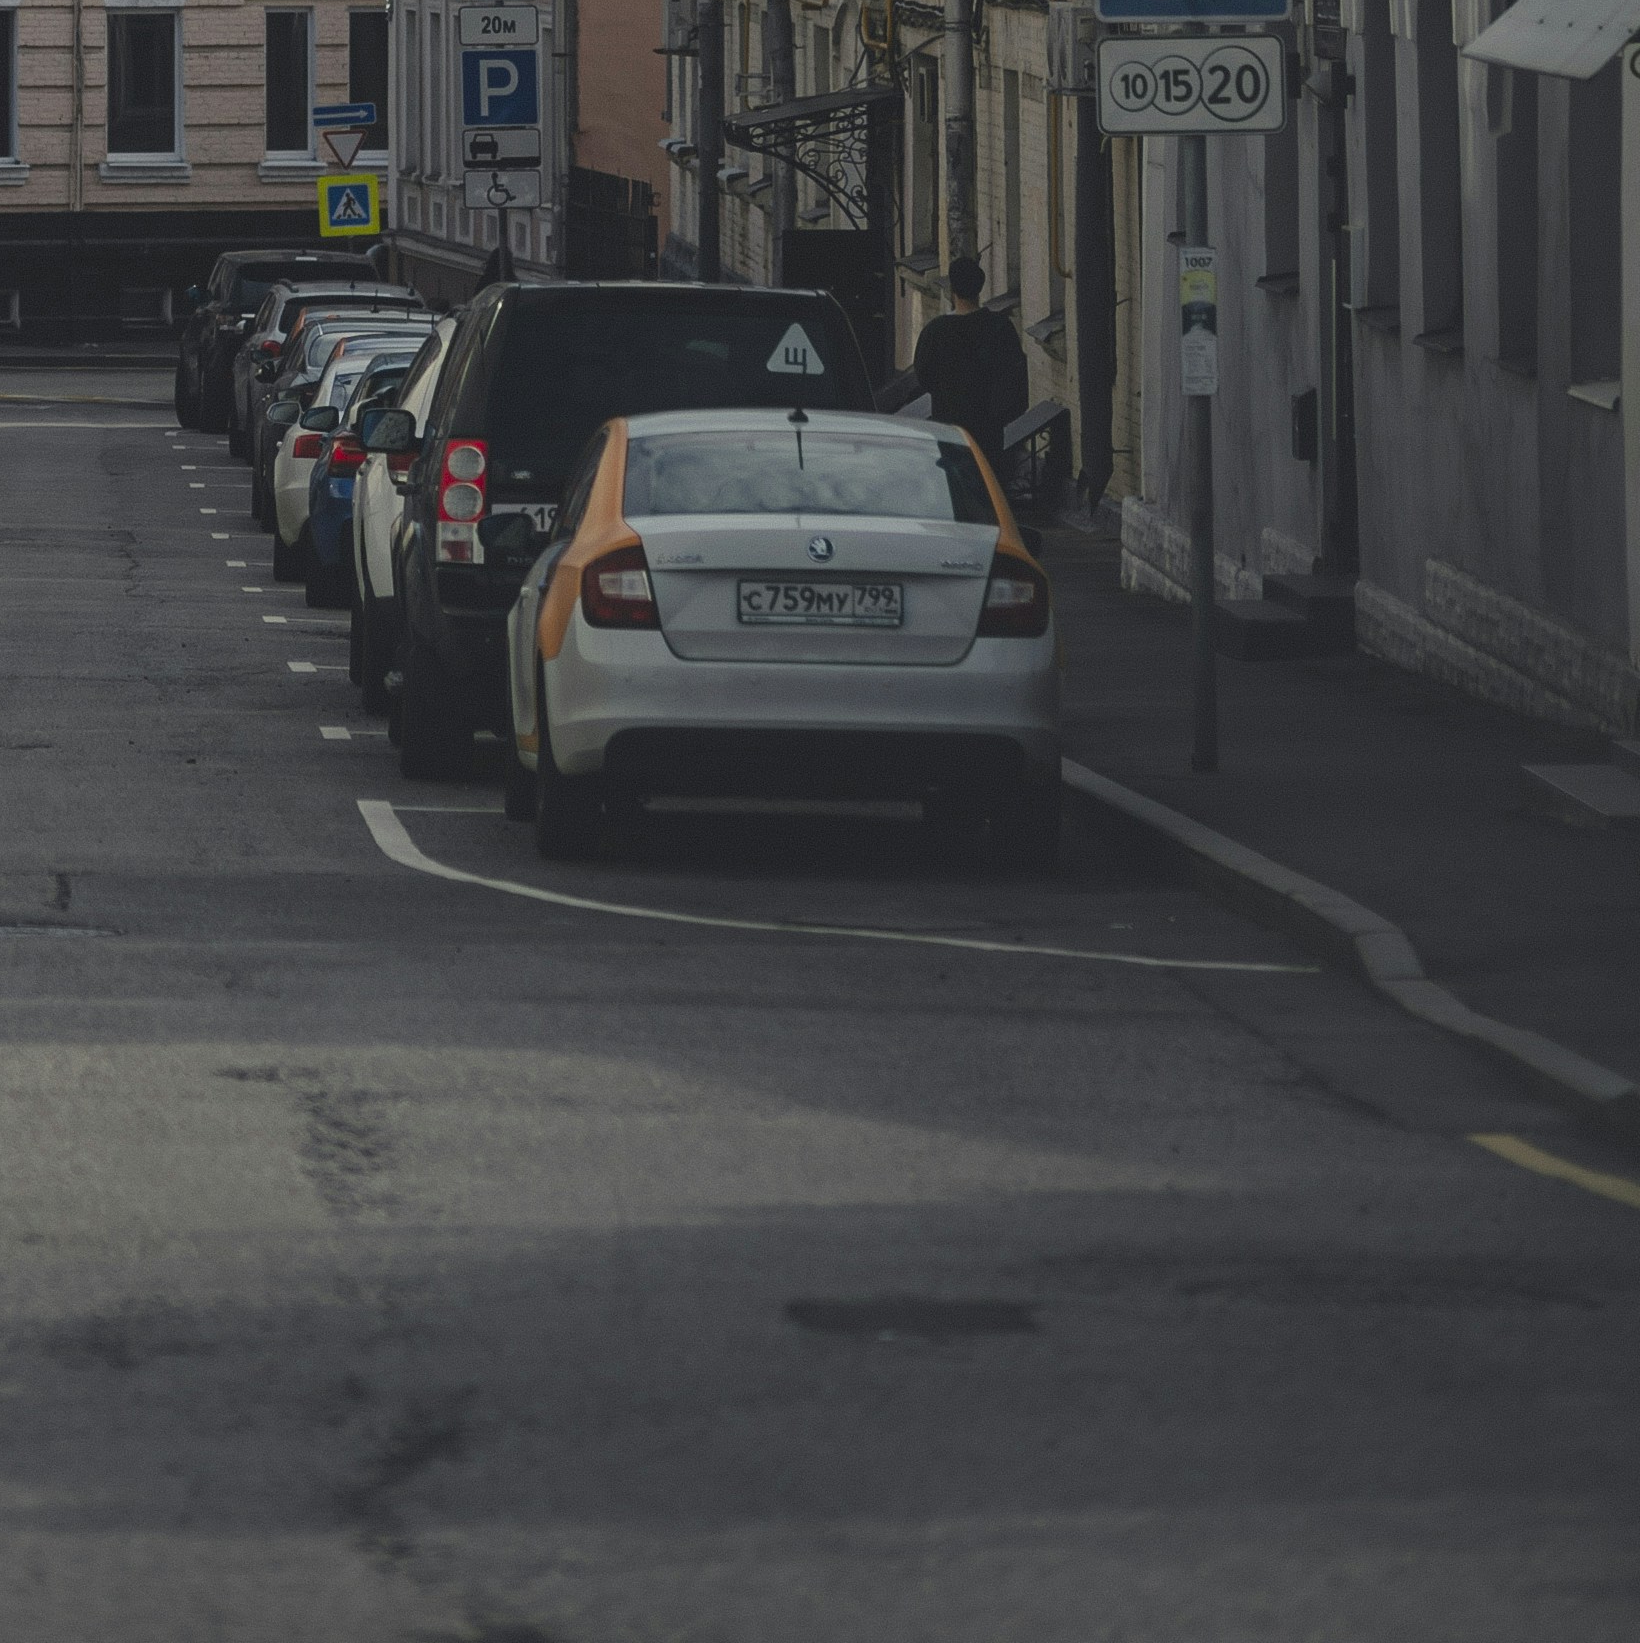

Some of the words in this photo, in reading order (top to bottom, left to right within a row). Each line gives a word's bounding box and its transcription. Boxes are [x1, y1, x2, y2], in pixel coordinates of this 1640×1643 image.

[479, 59, 519, 117] P
[1120, 73, 1148, 100] 10
[1159, 69, 1193, 102] 15
[1208, 64, 1261, 104] 20
[1185, 257, 1212, 267] 1007
[854, 586, 895, 607] 799
